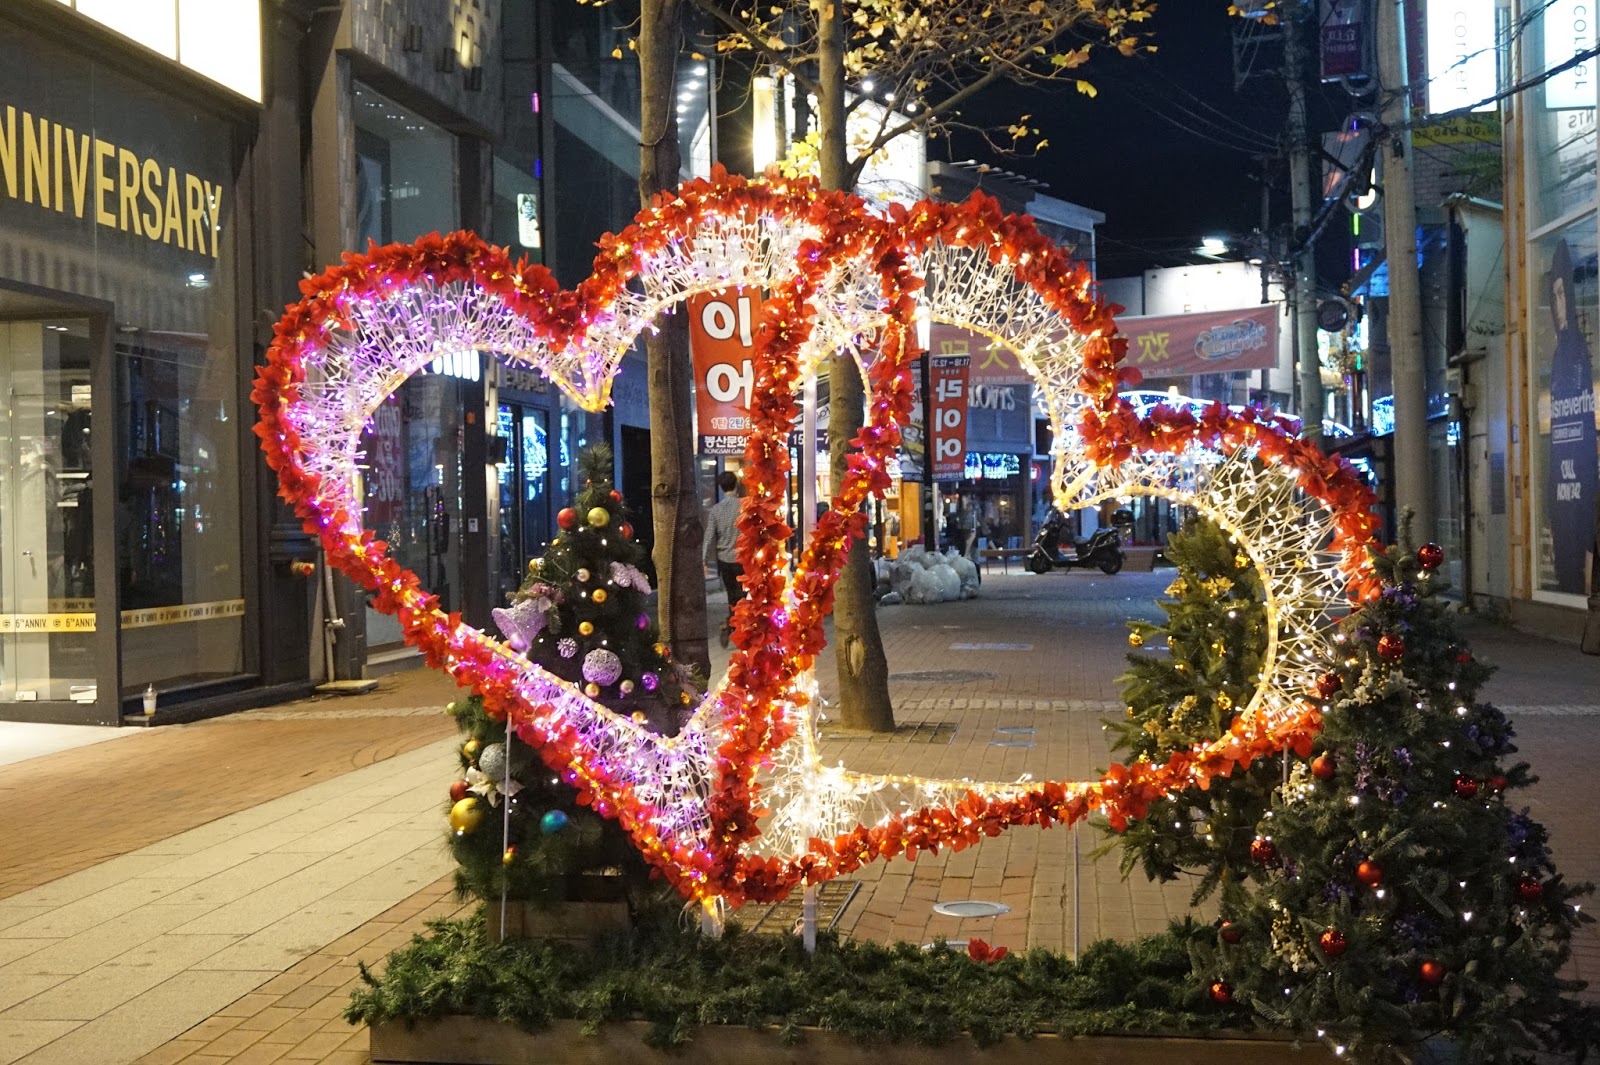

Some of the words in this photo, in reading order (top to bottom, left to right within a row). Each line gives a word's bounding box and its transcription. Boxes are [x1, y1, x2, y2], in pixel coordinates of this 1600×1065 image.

[711, 417, 727, 429] 1탄
[729, 417, 744, 429] 2탄
[704, 436, 749, 448] 봉산문화
